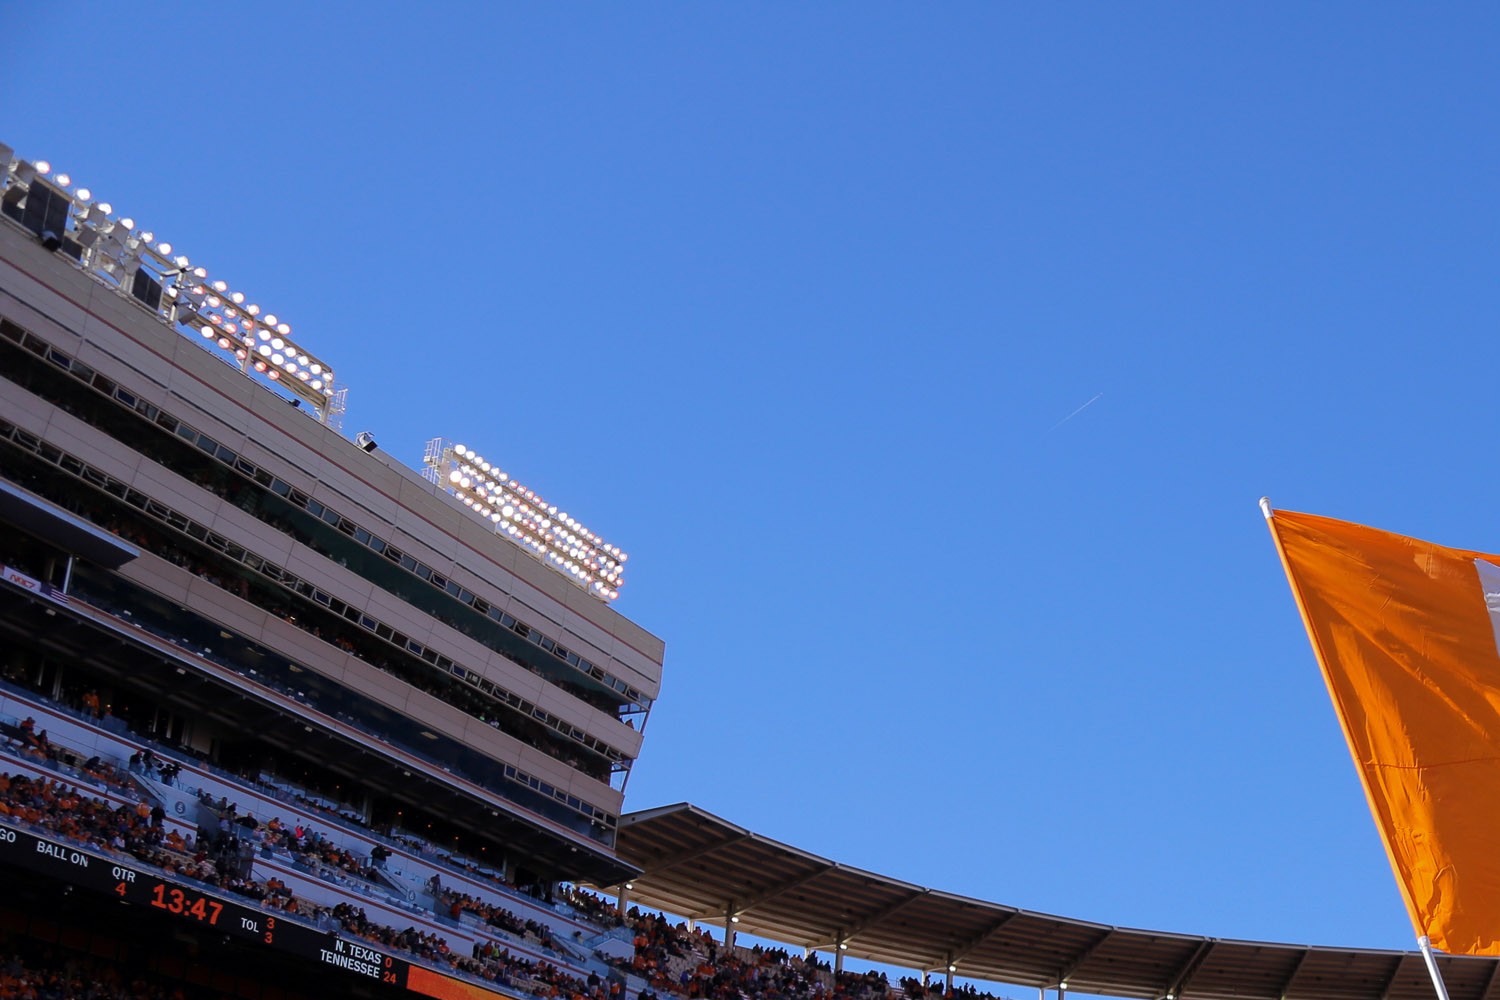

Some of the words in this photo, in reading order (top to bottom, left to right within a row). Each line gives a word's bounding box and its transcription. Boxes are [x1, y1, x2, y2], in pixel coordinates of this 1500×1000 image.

[36, 841, 68, 861] BALL
[70, 853, 89, 867] ON
[112, 866, 136, 883] QTR
[115, 882, 126, 896] 4
[151, 884, 224, 925] 13:47
[241, 917, 260, 933] TOL
[266, 917, 275, 929] 3
[264, 931, 273, 944] 3
[335, 940, 346, 954] N.
[349, 945, 382, 965] TEXAS
[385, 957, 393, 969] 0
[320, 949, 381, 978] TENNESSEE
[383, 971, 397, 984] 24
